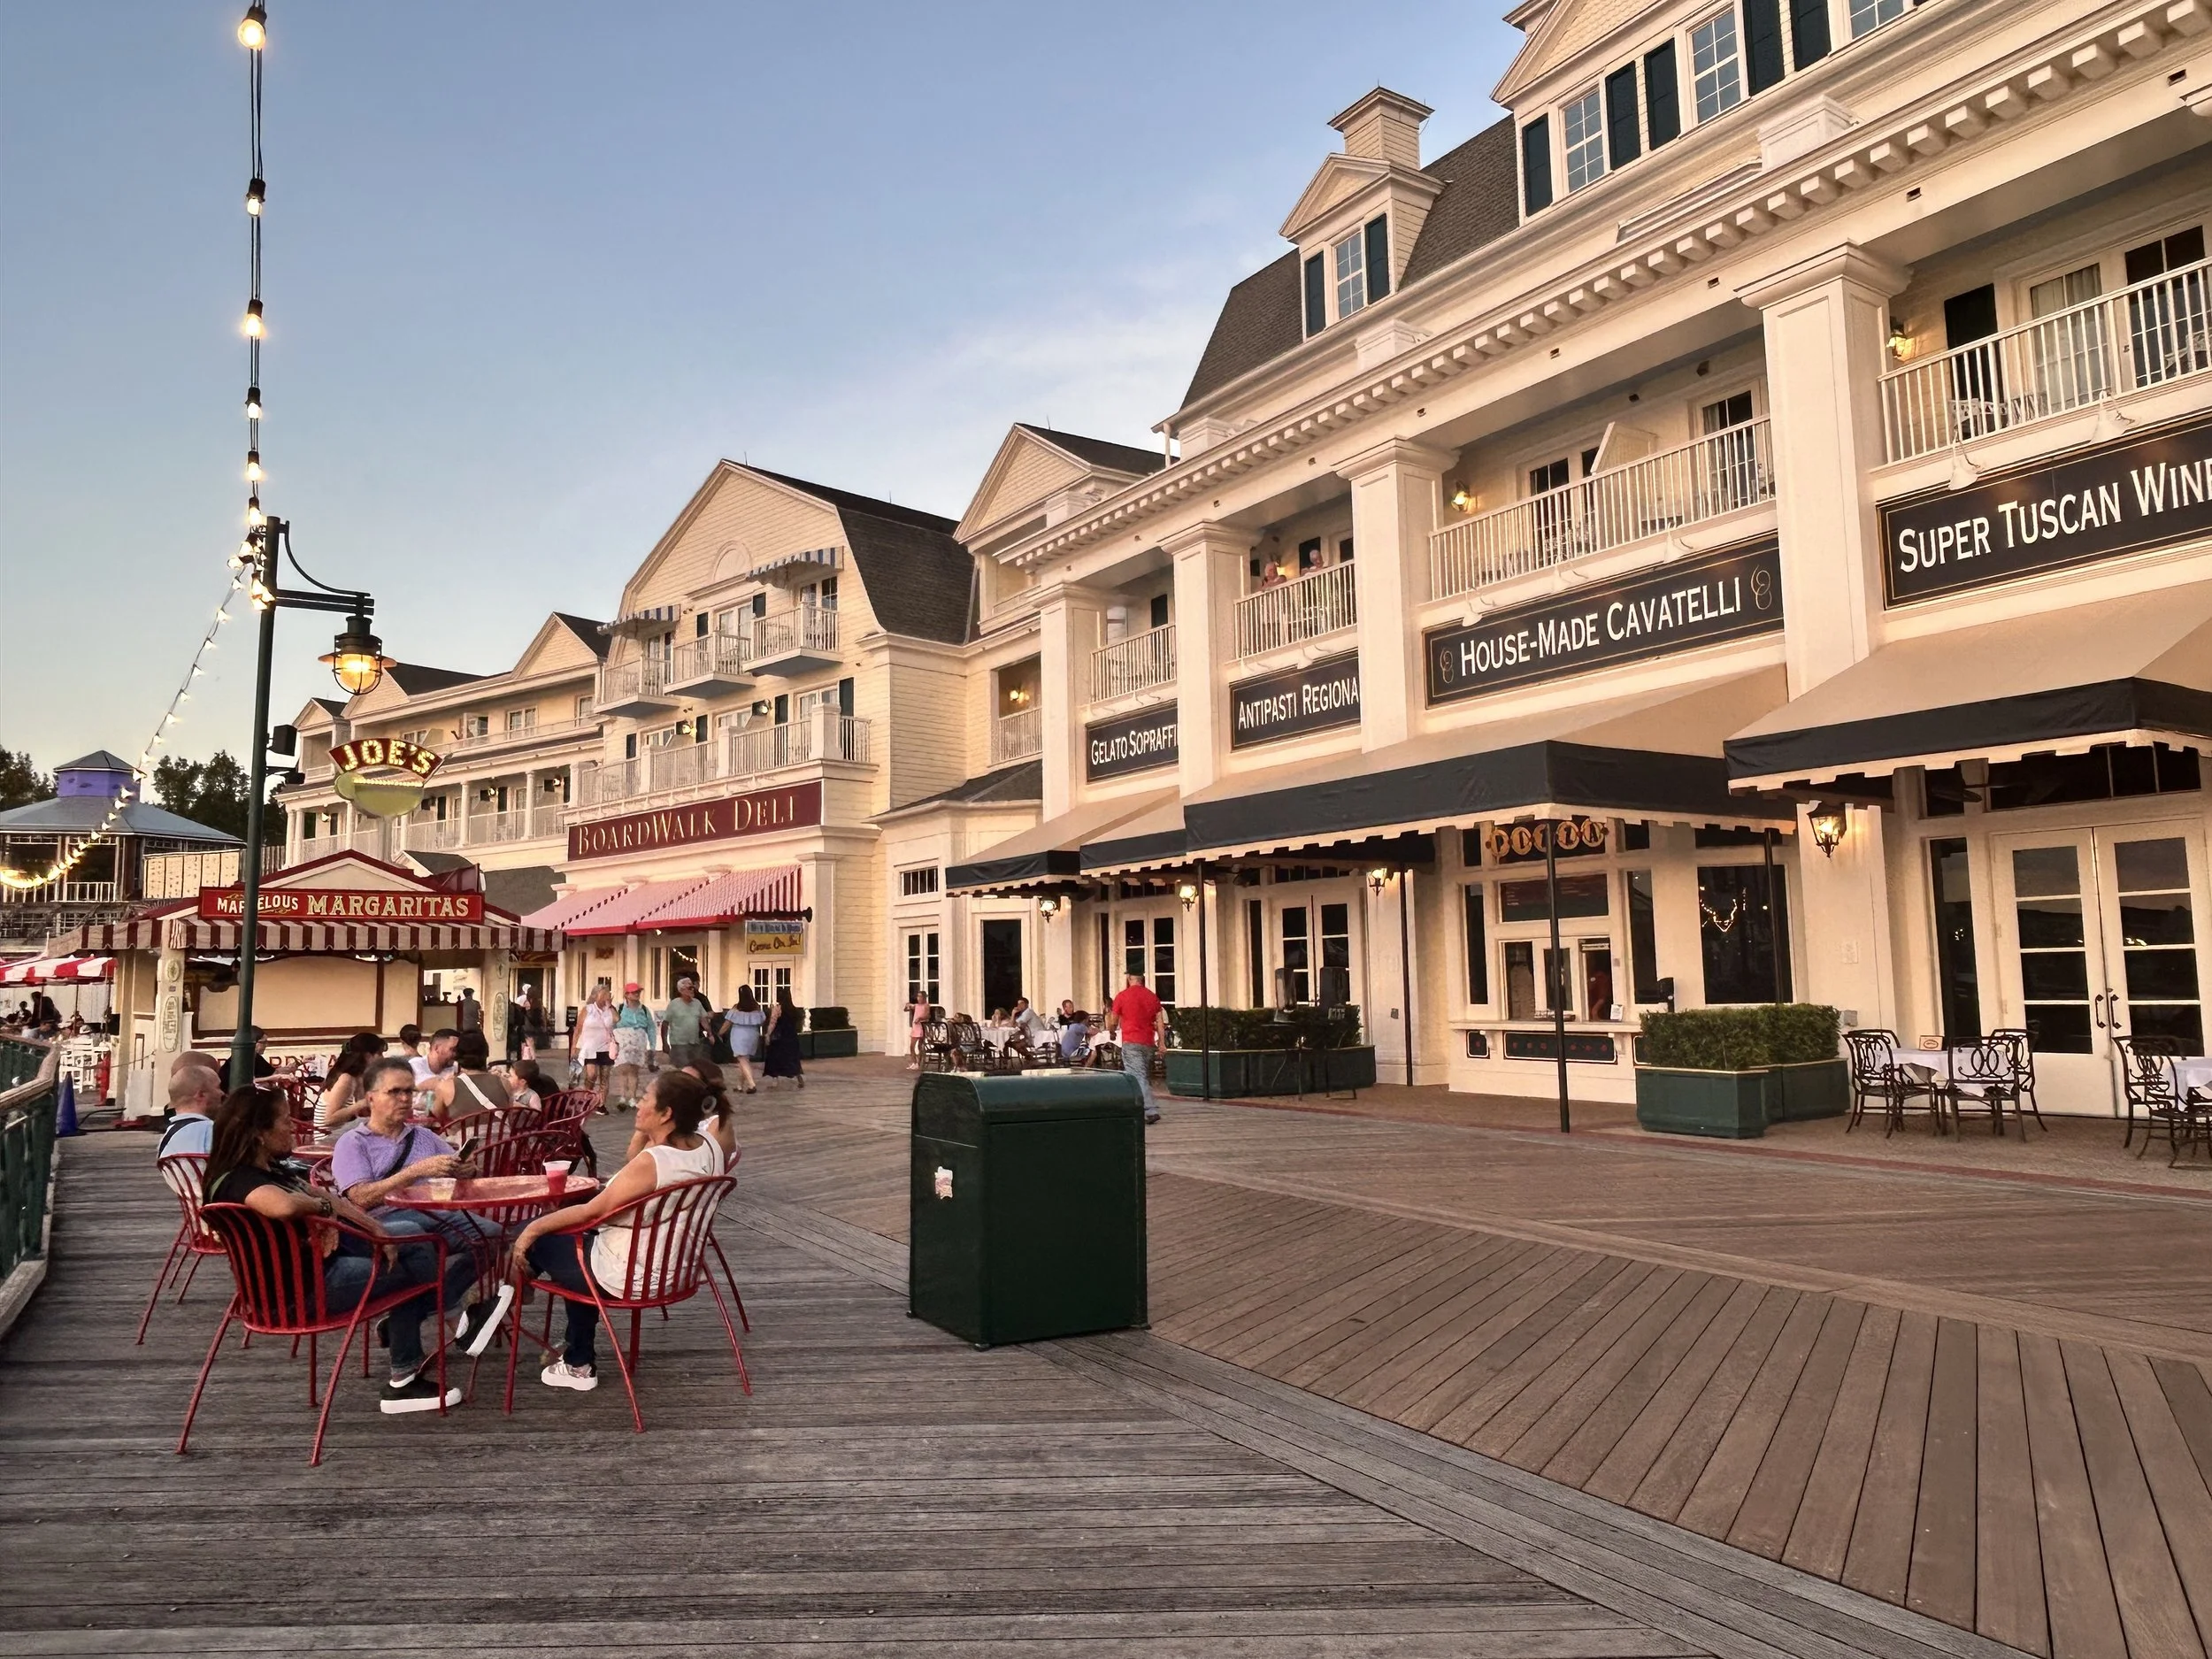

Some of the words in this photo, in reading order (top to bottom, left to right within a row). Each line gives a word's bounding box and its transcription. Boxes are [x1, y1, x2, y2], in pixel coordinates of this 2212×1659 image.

[1898, 516, 1992, 573] SUPER
[1997, 482, 2123, 549] TUSCAN
[1460, 612, 1600, 677] HOUSE-MADE
[1606, 576, 1741, 641] CAVATELLI
[1238, 692, 1297, 731] ANTIPASTI
[342, 739, 435, 774] JOE'S
[1091, 736, 1128, 765] GELATO
[578, 809, 717, 856] BOARDWALK
[733, 795, 795, 831] DELI
[217, 895, 299, 914] MARELOUS
[306, 895, 470, 917] MARGARITAS
